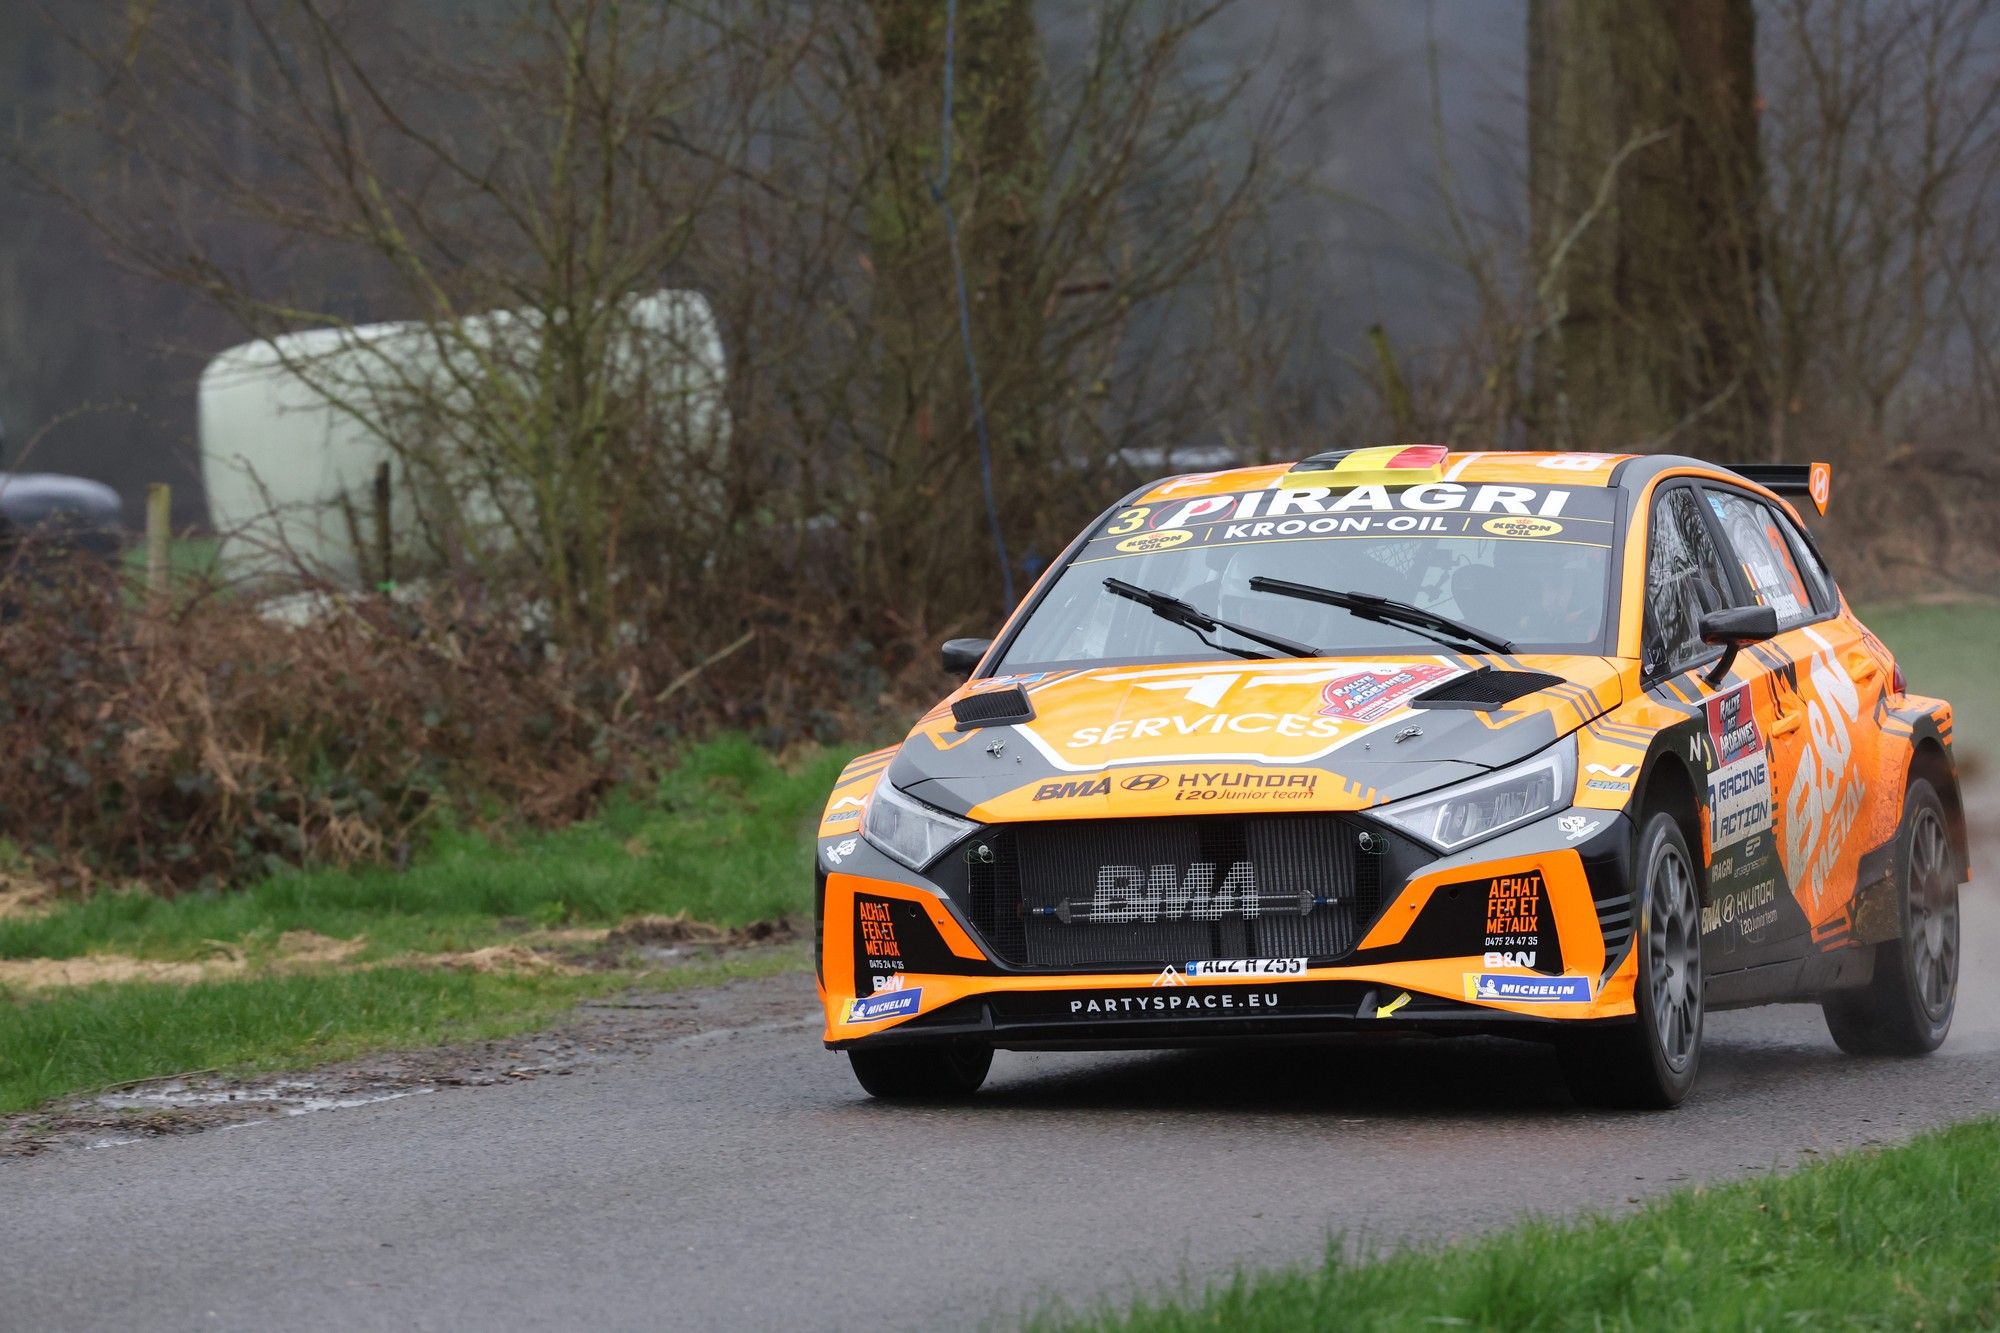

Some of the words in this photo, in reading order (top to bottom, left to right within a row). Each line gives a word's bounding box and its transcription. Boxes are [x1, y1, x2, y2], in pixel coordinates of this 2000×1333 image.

[1155, 485, 1571, 530] PIRAGRI
[1107, 507, 1152, 535] 3
[1223, 516, 1448, 540] KROON-OIL
[1493, 522, 1552, 532] KROON
[1126, 534, 1182, 548] KROON
[1506, 528, 1532, 537] OIL
[1138, 542, 1163, 551] OIL
[1067, 713, 1343, 748] SERVICES
[1033, 776, 1111, 801] BMA
[1178, 772, 1318, 788] HYUNDAI
[1718, 763, 1765, 803] RACING
[1272, 789, 1315, 800] team
[1720, 798, 1769, 839] ACTION
[1089, 861, 1259, 924] BMA
[1489, 877, 1540, 899] ACHAT
[1736, 878, 1775, 916] HYUNDAI
[859, 902, 890, 921] ACHAT
[1487, 898, 1516, 917] FER
[1520, 896, 1539, 916] ET
[862, 921, 882, 940] FER
[881, 922, 895, 940] ET
[1485, 937, 1503, 946] 0475
[1505, 937, 1515, 946] 24
[1516, 937, 1526, 946] 47
[1527, 936, 1538, 946] 35
[1483, 951, 1536, 968] B&N
[1500, 983, 1575, 995] MICHELIN
[866, 997, 912, 1016] MICHELIN
[1070, 993, 1278, 1013] PARTYSPACE.EU
